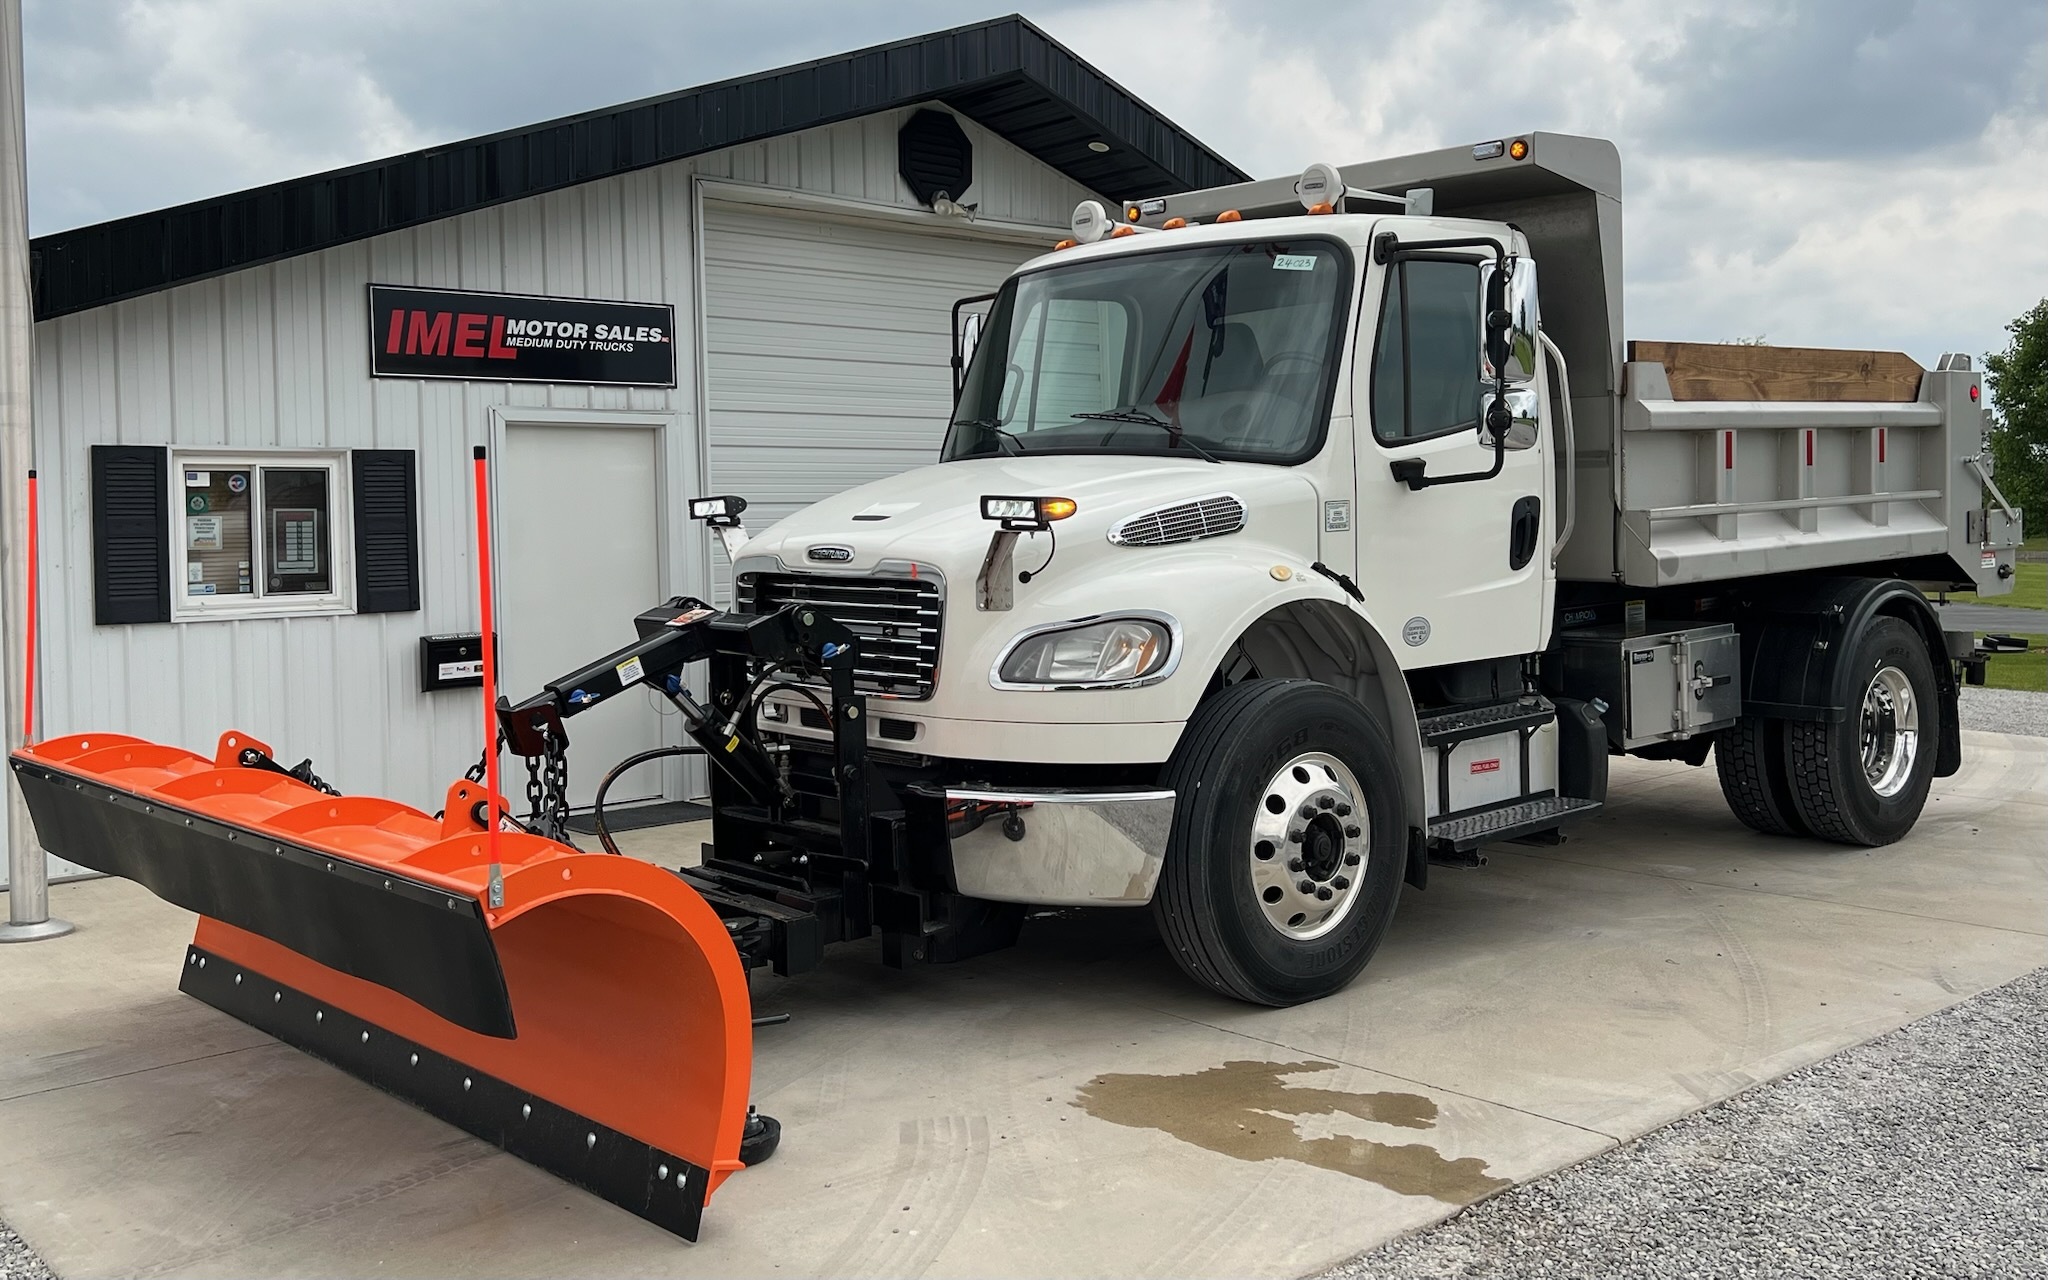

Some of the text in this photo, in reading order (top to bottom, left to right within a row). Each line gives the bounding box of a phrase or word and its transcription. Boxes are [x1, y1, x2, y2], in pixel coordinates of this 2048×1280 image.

[386, 309, 517, 360] IMEL
[507, 319, 588, 339] MOTOR
[595, 325, 662, 343] SALES
[506, 337, 634, 353] MEDIUM DUTY TRUCKS
